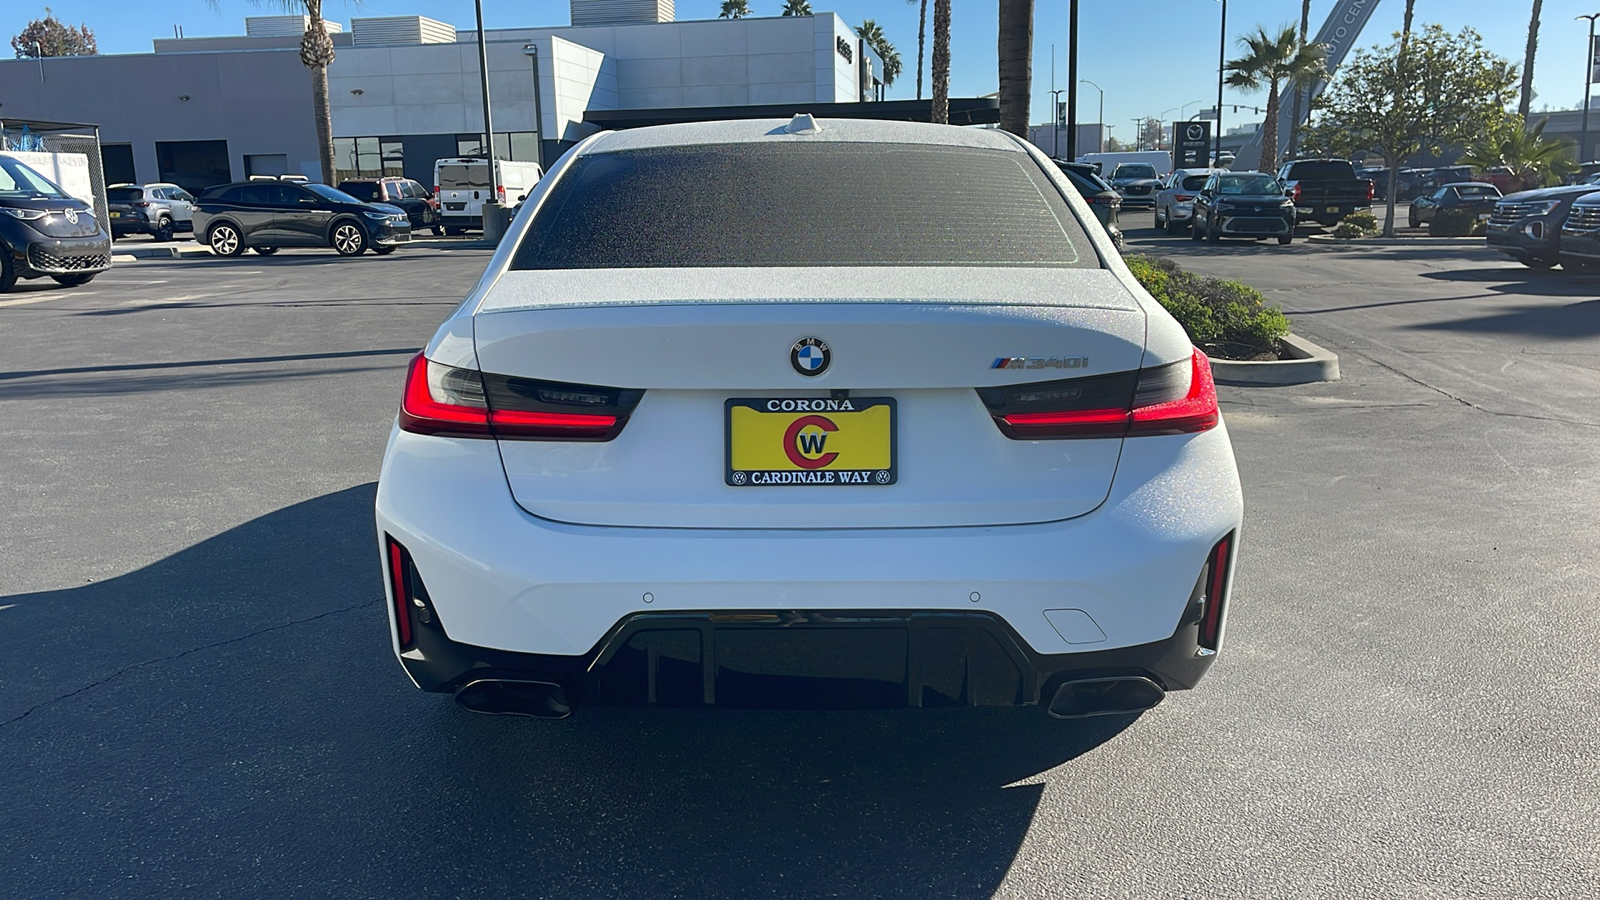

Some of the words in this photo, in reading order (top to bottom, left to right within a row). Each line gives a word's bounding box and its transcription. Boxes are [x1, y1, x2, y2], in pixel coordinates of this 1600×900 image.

[794, 337, 829, 352] BMW
[766, 399, 855, 411] CORONA
[751, 471, 835, 484] CARDINALE
[838, 471, 872, 484] WAY
